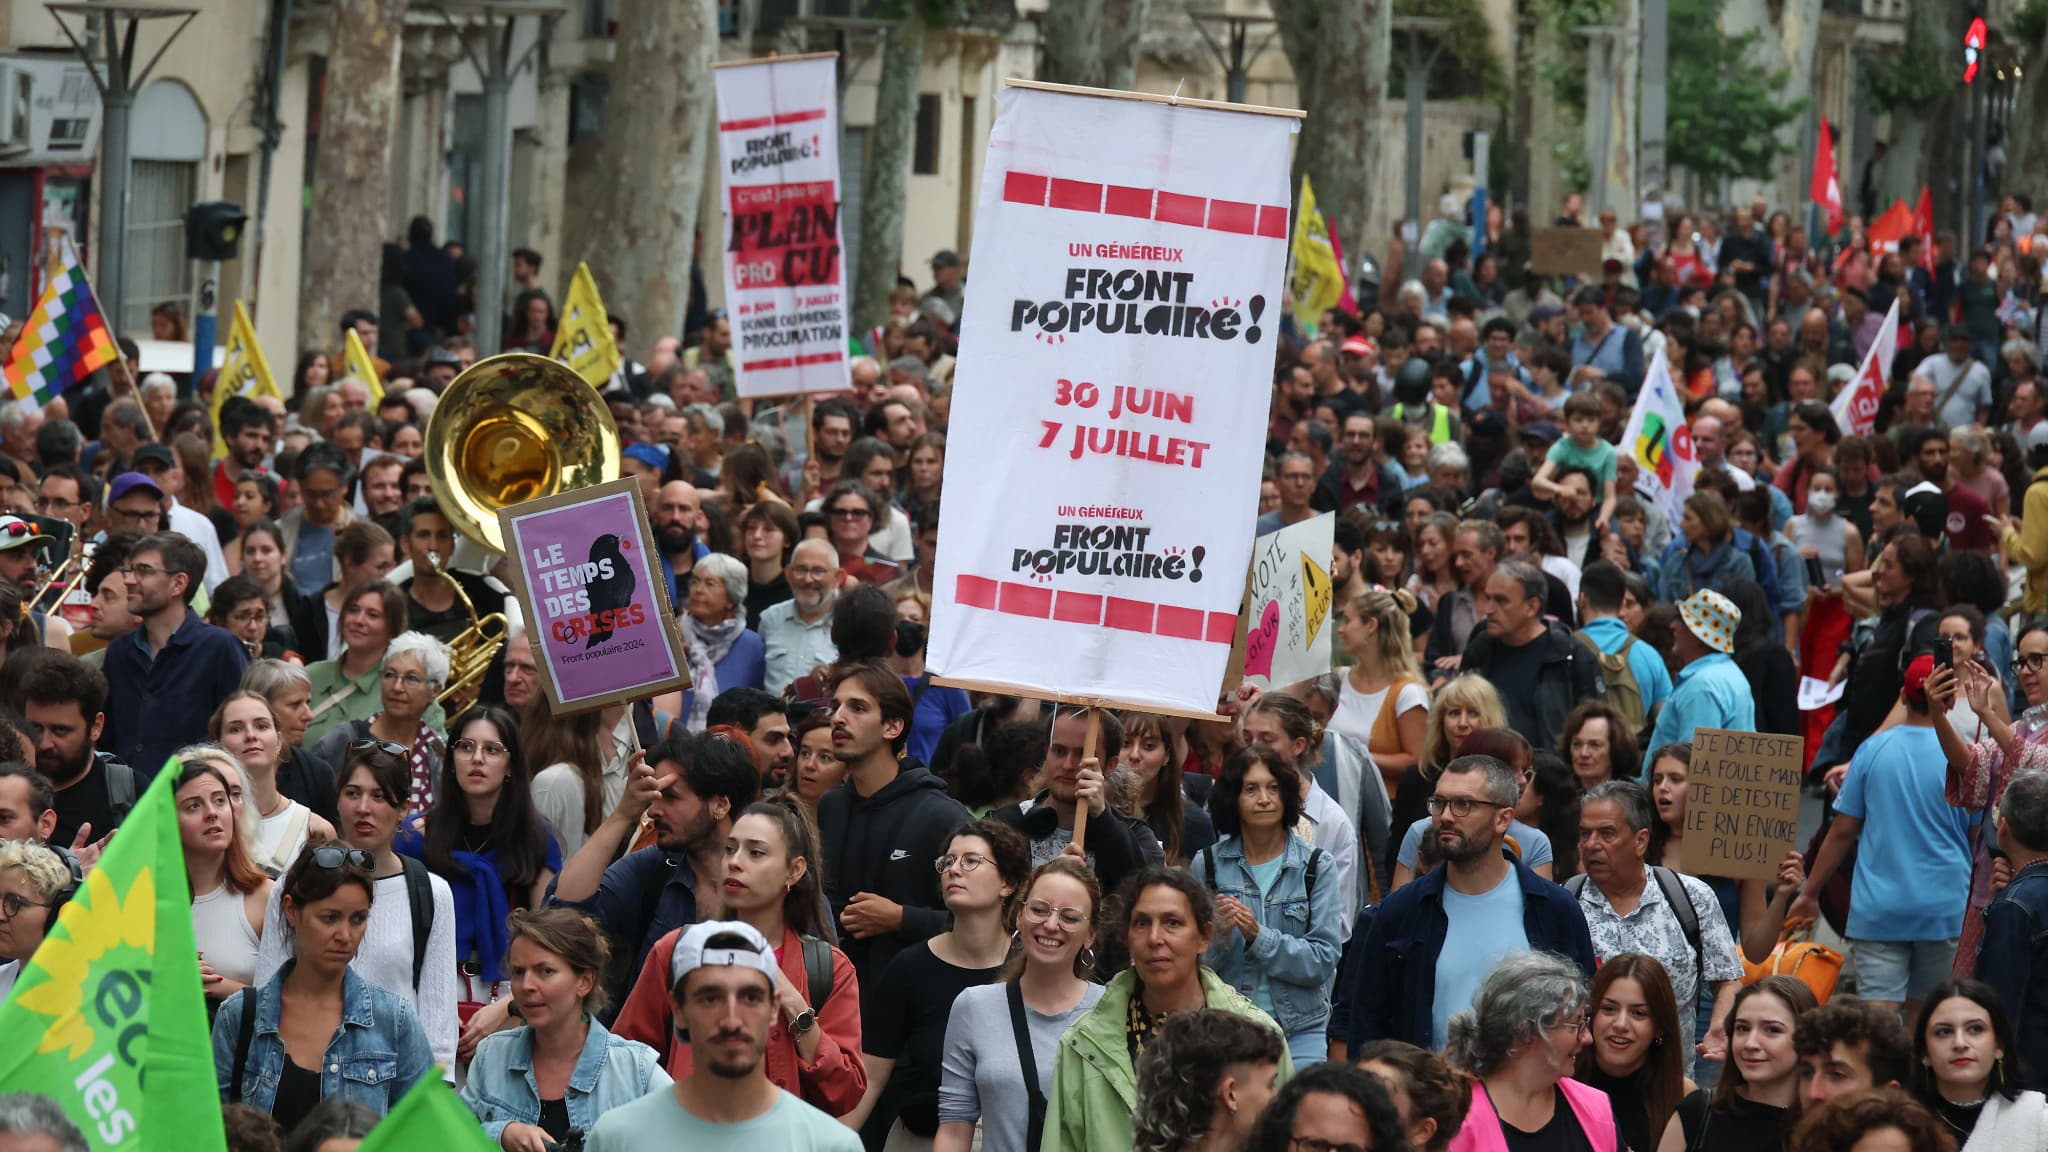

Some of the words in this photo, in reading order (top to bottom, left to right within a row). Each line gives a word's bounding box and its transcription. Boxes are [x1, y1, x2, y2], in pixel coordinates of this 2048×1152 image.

[746, 131, 791, 155] FRONT
[728, 202, 841, 252] PLAN
[736, 260, 776, 285] PRO
[782, 244, 840, 287] CU
[1069, 242, 1092, 258] UN
[1096, 241, 1183, 262] GÉNÉREUX
[1065, 268, 1194, 304] FRONT
[743, 325, 841, 350] PROCURATION
[1054, 378, 1100, 409] 30
[1108, 385, 1194, 424] JUIN
[1037, 420, 1064, 448] 7
[1070, 424, 1211, 469] JUILLET
[1057, 506, 1076, 517] UN
[1078, 504, 1144, 520] GÉNÉREUX
[1053, 524, 1151, 552] FRONT
[533, 543, 565, 568] LE
[1251, 532, 1286, 599] VOTE
[539, 558, 615, 593] TEMPS
[544, 589, 591, 618] DES
[561, 653, 585, 665] Front
[585, 645, 622, 661] populaire
[624, 639, 645, 651] 2024
[1695, 732, 1720, 753] JE
[1726, 735, 1799, 757] DETESTE
[1693, 759, 1711, 776] LA
[1718, 760, 1764, 782] FOULE
[1769, 767, 1800, 787] MAIS
[1688, 782, 1713, 805] JE
[1721, 785, 1792, 811] DETESTE
[1687, 808, 1706, 831] LE
[1714, 811, 1740, 835] RN
[1746, 814, 1797, 843] ENCORE
[75, 1053, 135, 1146] les
